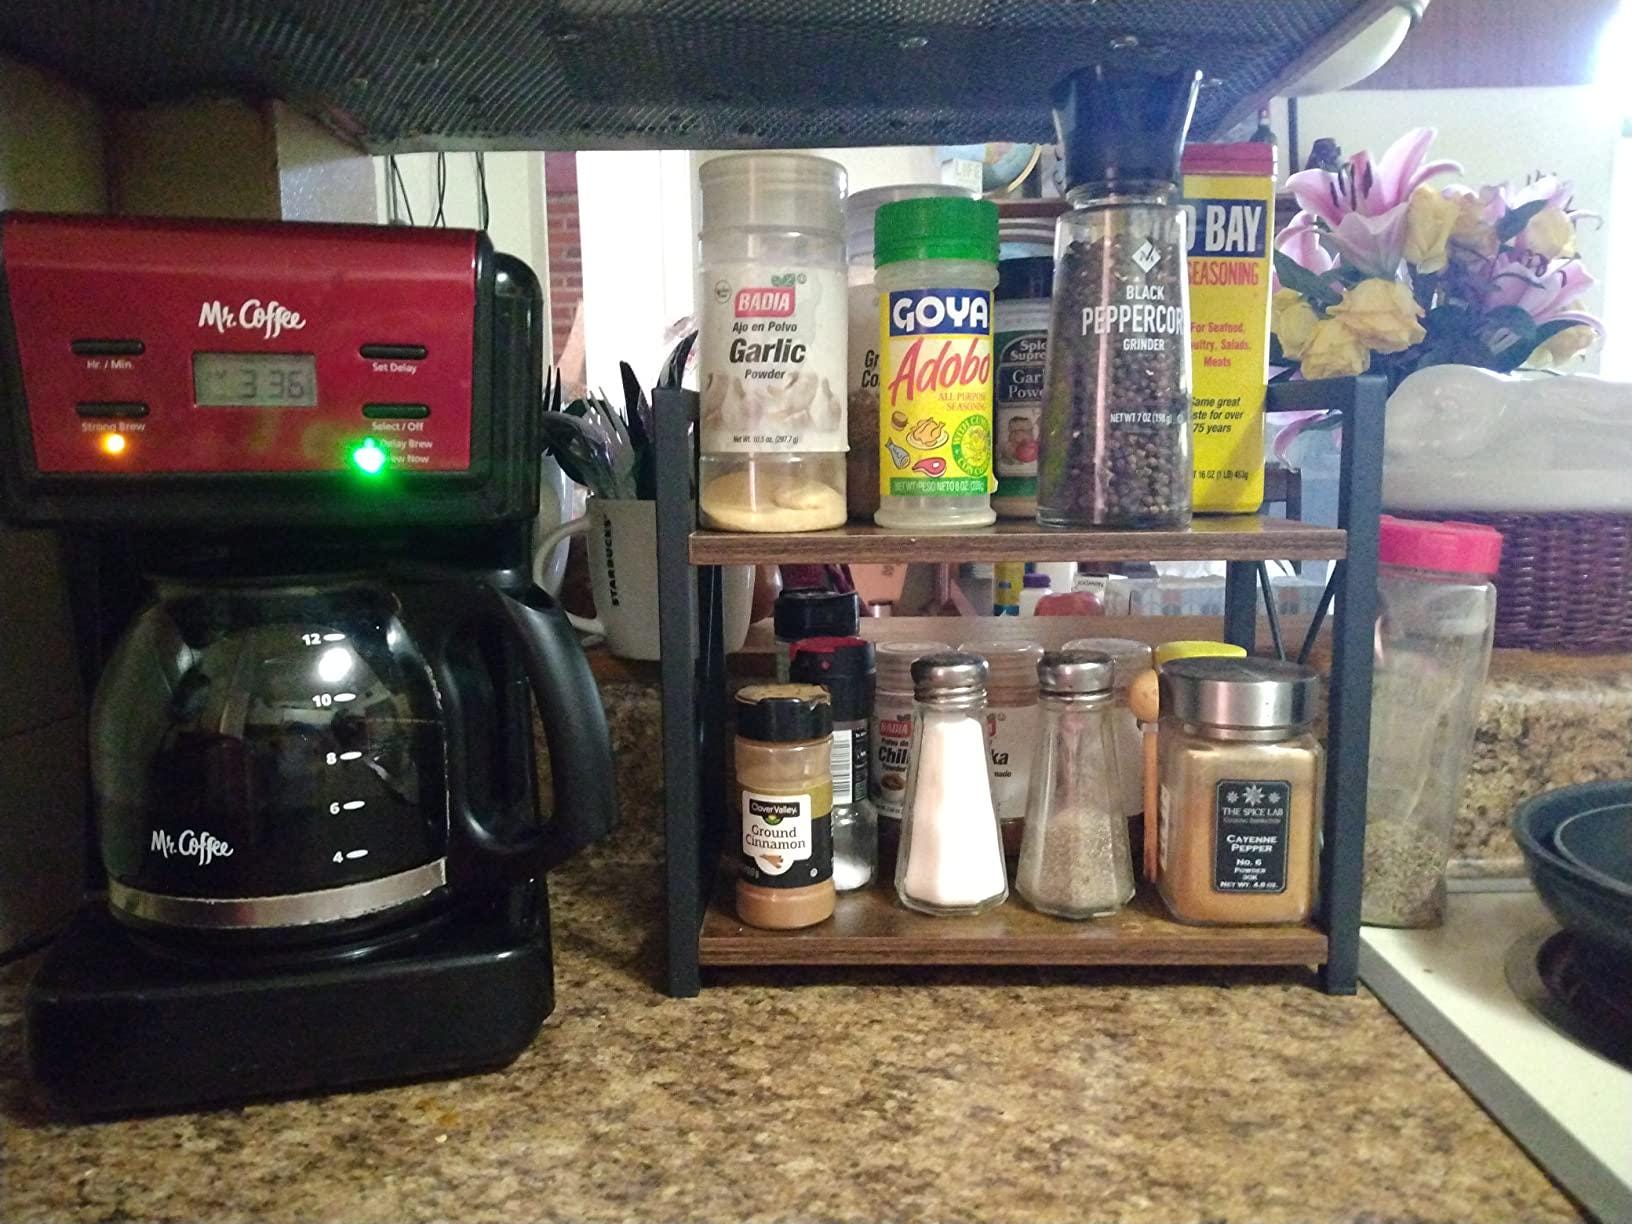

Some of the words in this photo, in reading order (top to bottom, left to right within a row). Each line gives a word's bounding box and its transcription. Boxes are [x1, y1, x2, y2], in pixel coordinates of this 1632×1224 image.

[1205, 205, 1262, 252] BAY
[1126, 285, 1165, 300] BLACK
[738, 292, 790, 312] BADIA
[199, 300, 237, 334] Mr.
[239, 299, 307, 340] Coffee
[893, 295, 988, 333] GOYA
[1082, 304, 1184, 336] PEPPERCOR
[732, 322, 748, 334] Ajo
[751, 322, 765, 332] en
[768, 321, 797, 332] Polvo
[729, 337, 807, 364] Garlic
[1020, 340, 1049, 353] Spic
[1123, 338, 1165, 351] GRINDER
[1010, 350, 1048, 362] Supre
[1203, 356, 1232, 368] Meats
[372, 362, 389, 372] Set
[390, 363, 417, 375] Delay
[744, 368, 786, 380] Powder
[888, 336, 990, 407] Adobo
[1008, 384, 1042, 399] Pow
[1217, 396, 1241, 409] great
[1110, 412, 1122, 423] NET
[1136, 413, 1142, 423] 7
[1142, 412, 1152, 423] OZ
[1192, 410, 1208, 420] ste
[1209, 410, 1223, 420] for
[1224, 411, 1244, 420] over
[82, 422, 117, 433] Strong
[118, 421, 146, 432] Brew
[372, 422, 400, 432] Select
[407, 422, 424, 432] Off
[1193, 422, 1206, 433] 75
[1206, 424, 1232, 435] years
[408, 439, 434, 449] Brew
[407, 454, 430, 463] Now
[604, 518, 619, 606] STARBUCKS
[302, 634, 322, 646] 12
[312, 694, 332, 707] 10
[326, 752, 337, 765] 8
[878, 745, 909, 765] Chil
[329, 802, 340, 814] 6
[1223, 808, 1241, 816] THE
[1243, 808, 1265, 816] SPICE
[1267, 808, 1283, 816] LAB
[751, 823, 797, 839] Ground
[151, 829, 177, 859] Mr.
[178, 829, 235, 866] Coffee
[745, 833, 807, 851] Cinnamon
[333, 851, 344, 863] 4
